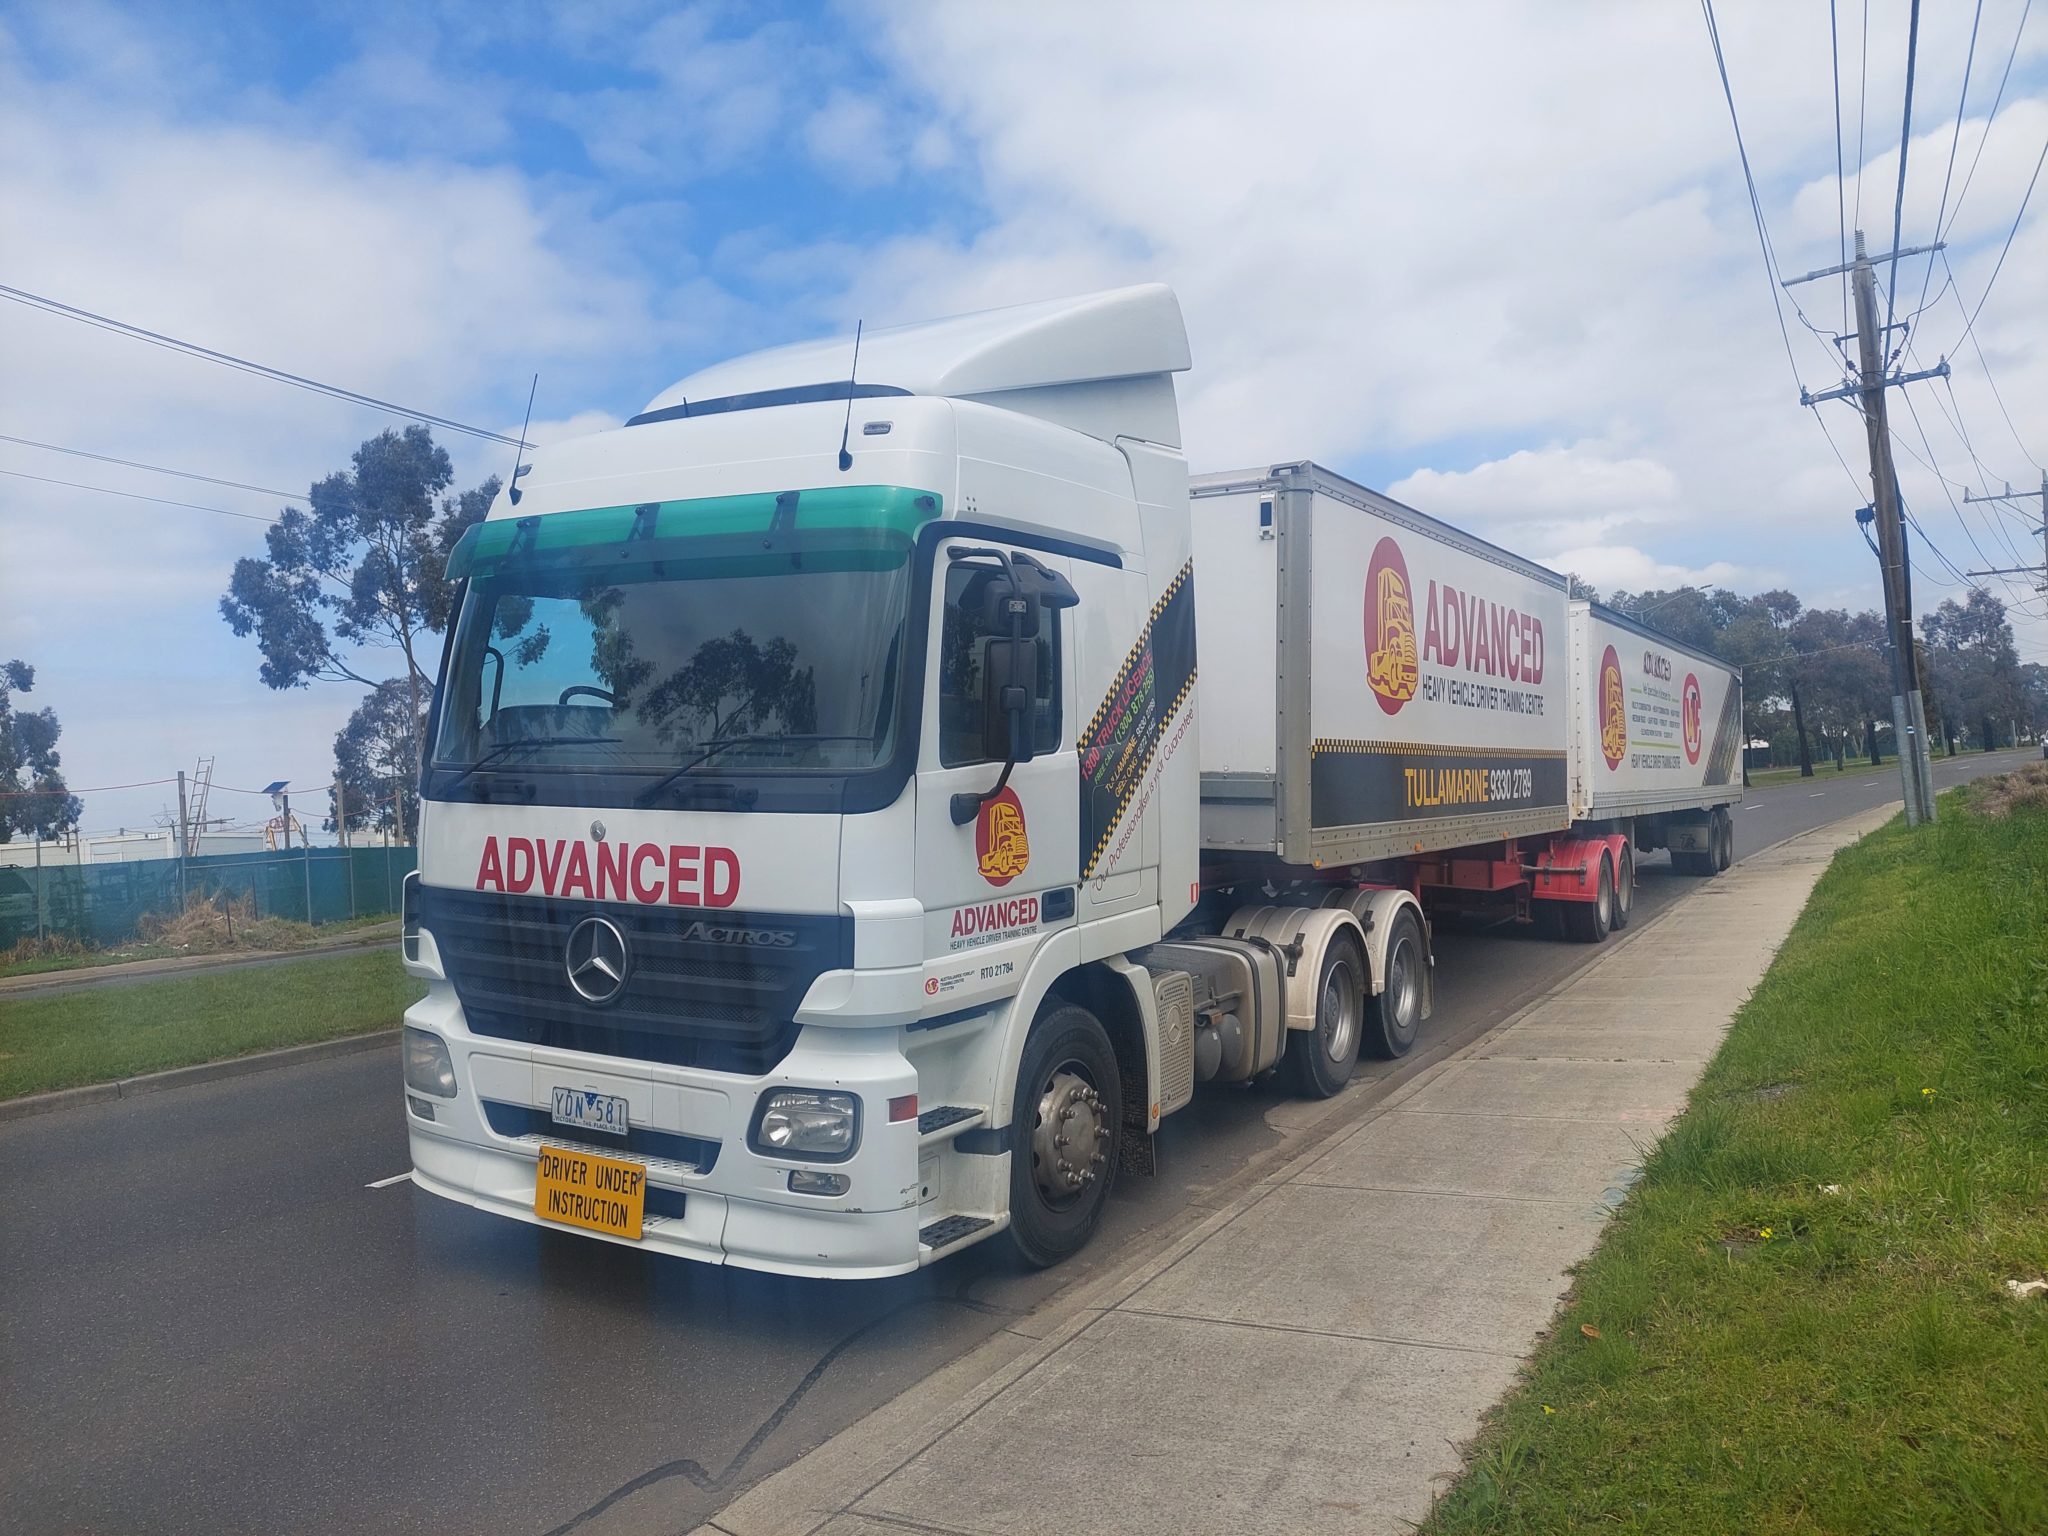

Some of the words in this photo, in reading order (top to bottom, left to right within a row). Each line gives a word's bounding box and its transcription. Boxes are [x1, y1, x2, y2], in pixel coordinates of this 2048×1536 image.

[1423, 579, 1544, 685] ADVANCED
[1081, 746, 1100, 780] 1300
[1096, 705, 1124, 749] TRUCK
[1122, 649, 1153, 705] LICENCE
[1422, 674, 1446, 703] HEAVY
[1447, 679, 1475, 708] VEHICLE
[1476, 684, 1498, 710] DRIVER
[1499, 688, 1525, 714] TRAINING
[1525, 693, 1544, 716] CENTRE
[1094, 765, 1106, 784] FREE
[1104, 747, 1115, 766] CALL
[1114, 710, 1133, 745] (1300
[1131, 690, 1145, 714] 878
[1404, 768, 1489, 807] TULLAMARINE
[1490, 769, 1512, 801] 9330
[1513, 768, 1532, 799] 2789
[1108, 788, 1150, 867] Professionalism
[476, 836, 741, 908] ADVANCED
[949, 940, 965, 950] HEAVY
[966, 936, 985, 947] VEHICLE
[985, 932, 1001, 943] DRIVER
[1002, 929, 1021, 940] TRAINING
[1021, 925, 1038, 937] CENTRE
[951, 897, 1039, 938] ADVANCED
[980, 966, 993, 980] RTO
[994, 961, 1014, 976] 21784
[555, 1092, 584, 1119] YDN
[596, 1099, 623, 1126] 581
[555, 1115, 576, 1124] VICTORIA
[543, 1155, 587, 1186] DRIVER
[595, 1165, 638, 1196] UNDER
[548, 1188, 628, 1229] INSTRUCTION
